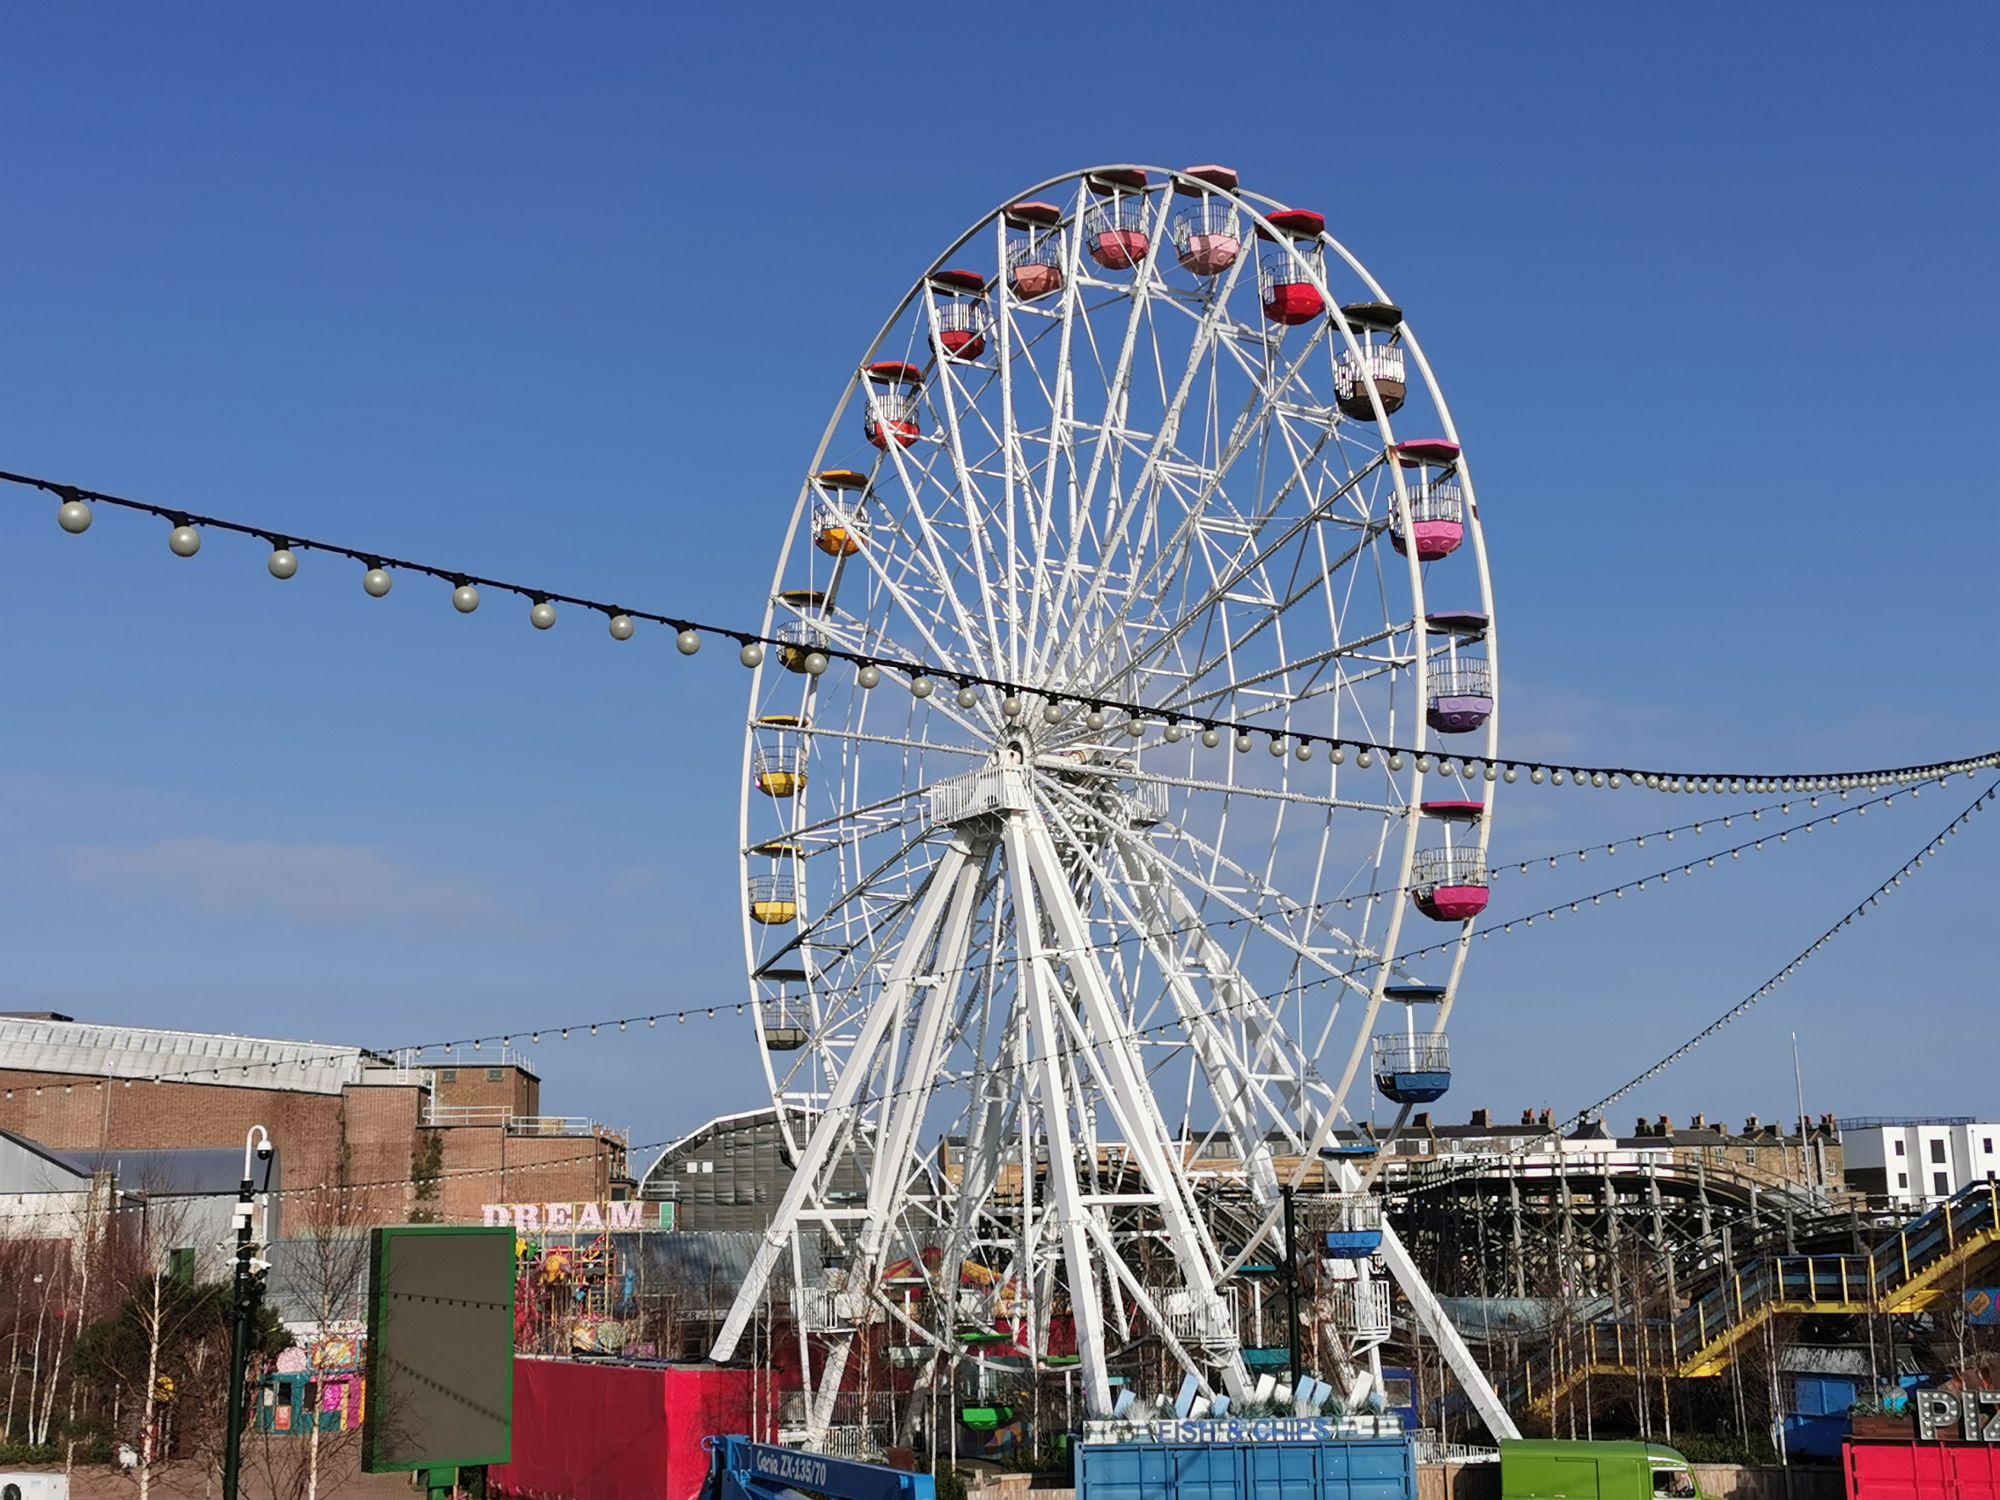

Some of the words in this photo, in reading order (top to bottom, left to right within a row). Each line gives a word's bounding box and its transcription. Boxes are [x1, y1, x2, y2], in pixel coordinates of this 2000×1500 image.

[481, 1201, 644, 1231] DREAM
[1158, 1421, 1216, 1443] FISH
[1227, 1418, 1244, 1442] &
[1253, 1418, 1330, 1442] CHIPS
[756, 1449, 779, 1475] Genie
[780, 1454, 827, 1487] ZX-135/70
